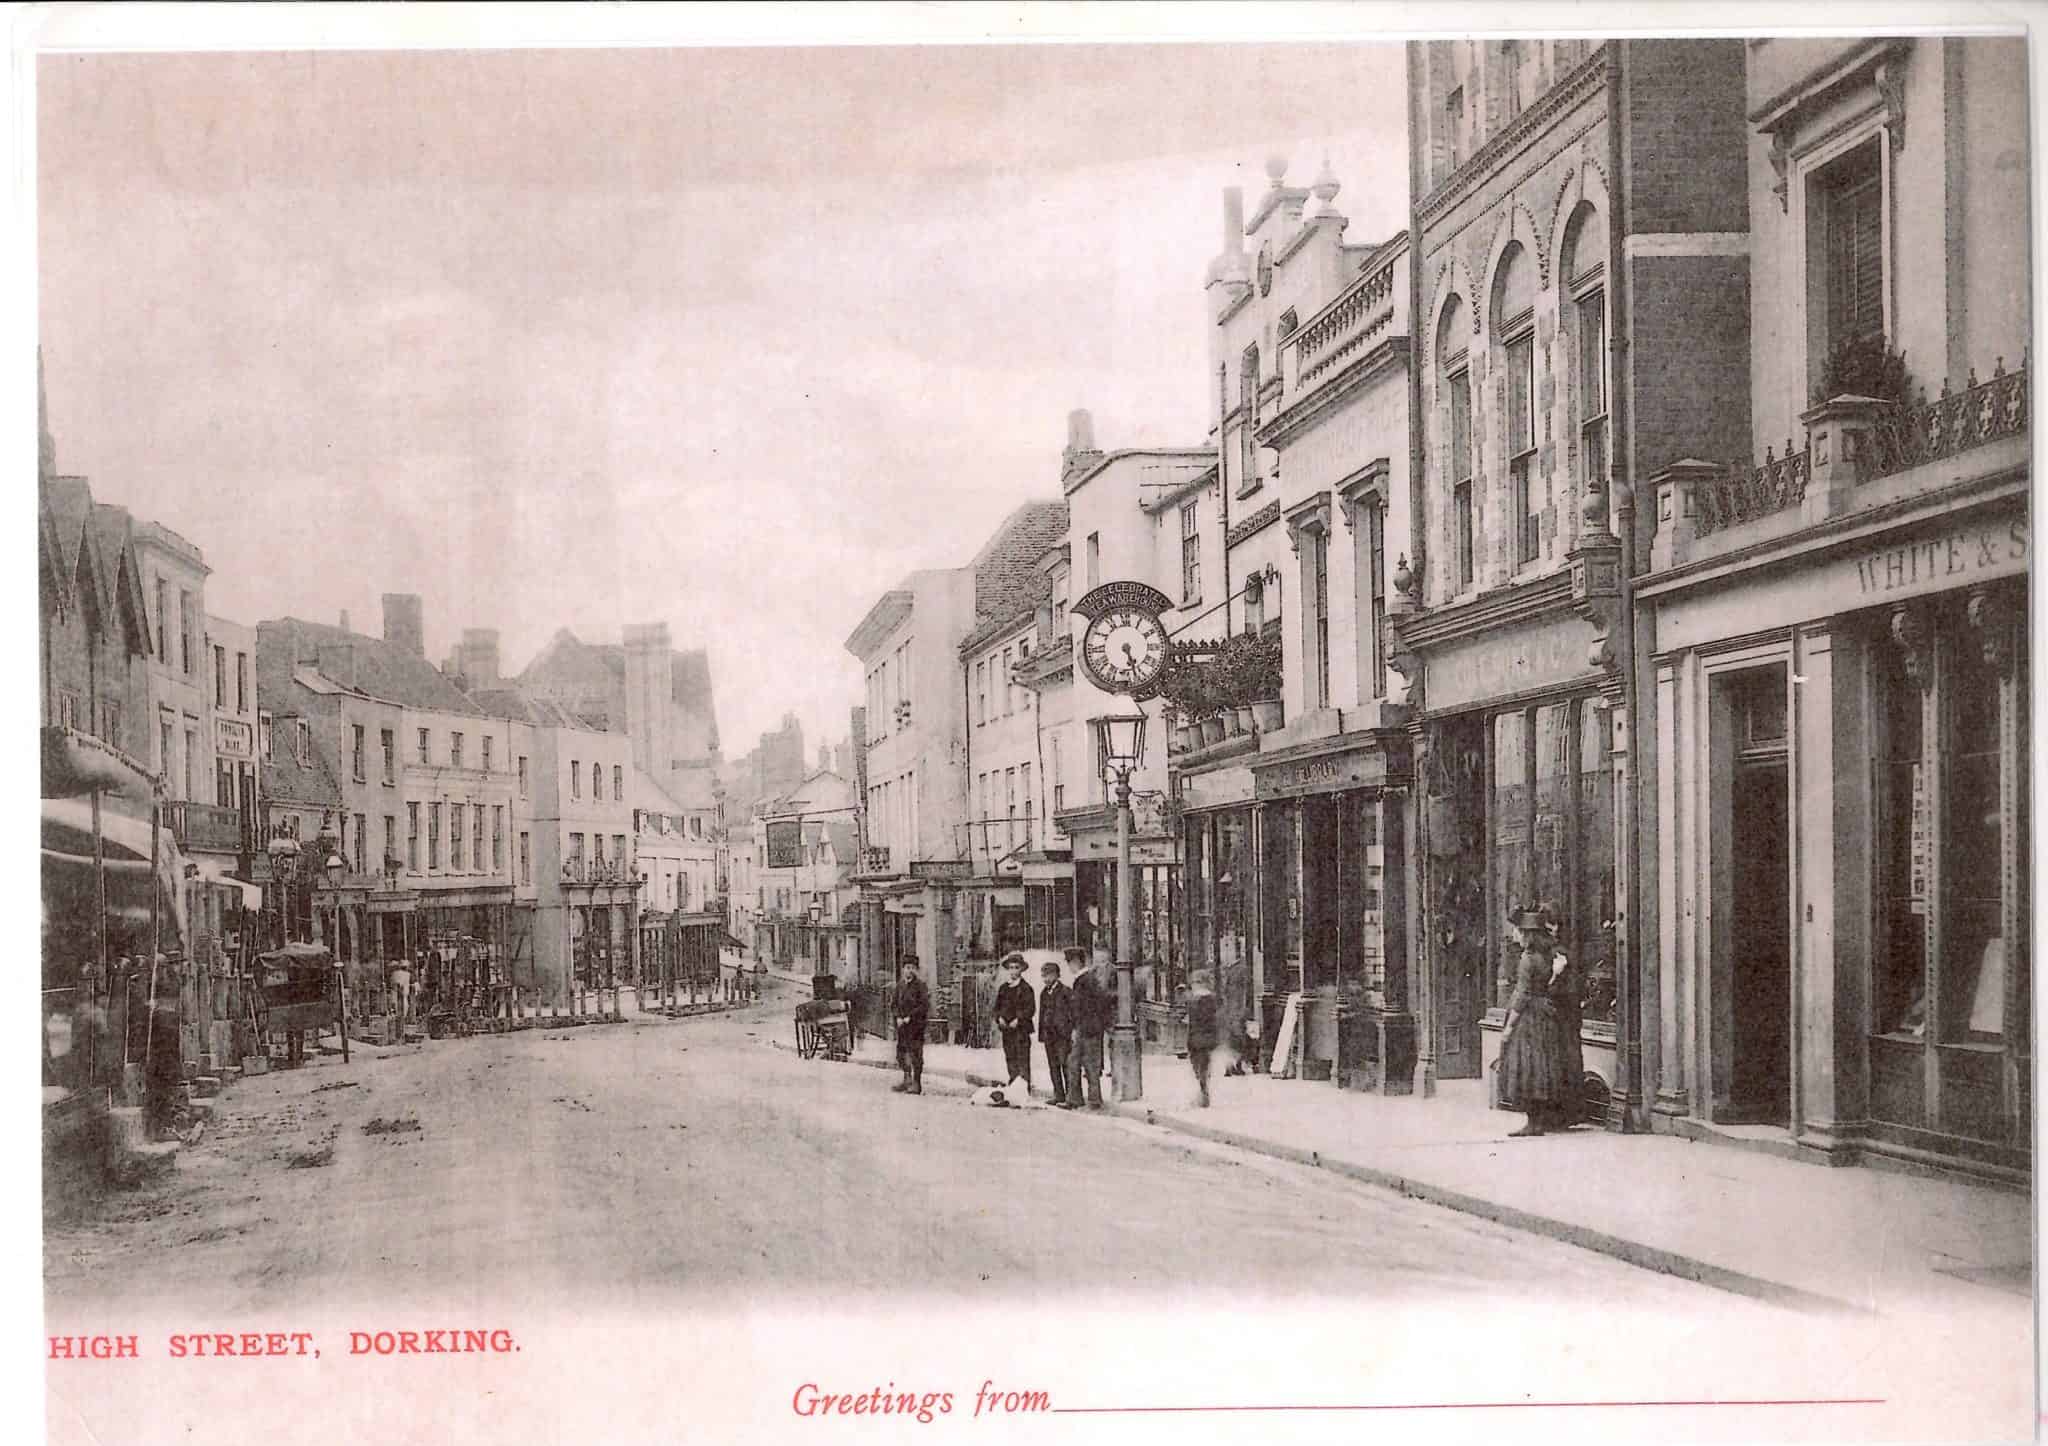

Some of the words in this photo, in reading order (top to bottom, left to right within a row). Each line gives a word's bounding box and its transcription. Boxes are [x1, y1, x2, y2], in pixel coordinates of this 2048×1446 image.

[1857, 536, 1966, 593] WHITE
[1975, 530, 1999, 568] &
[1079, 591, 1101, 609] THE
[1089, 599, 1109, 611] TEA
